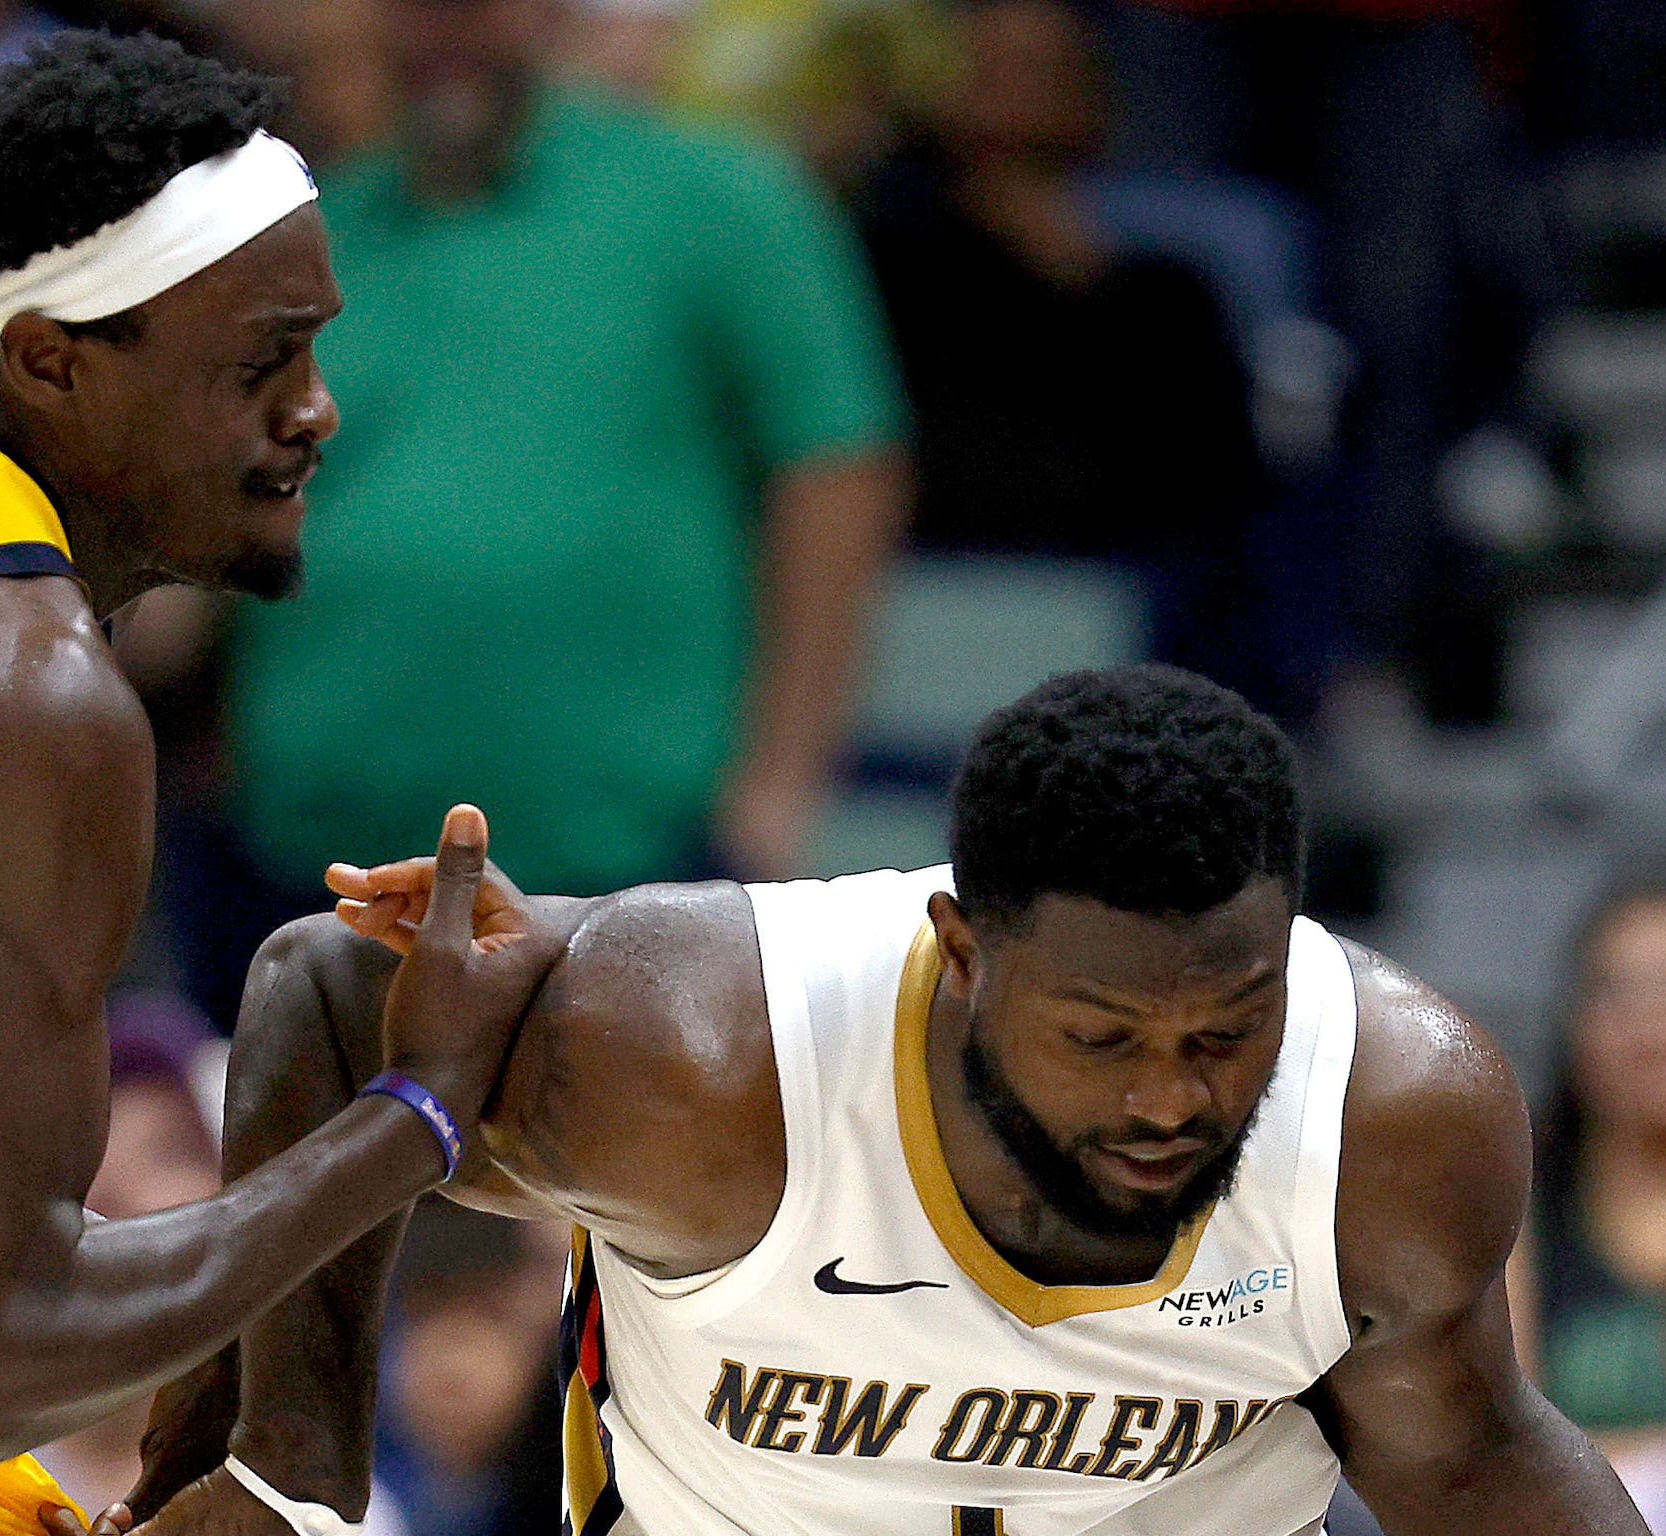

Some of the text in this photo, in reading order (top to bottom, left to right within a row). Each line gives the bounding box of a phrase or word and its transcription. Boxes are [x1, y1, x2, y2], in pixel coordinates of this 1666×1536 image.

[1177, 1299, 1264, 1327] GRILLS
[704, 1357, 1297, 1482] NEW ORLEAN
